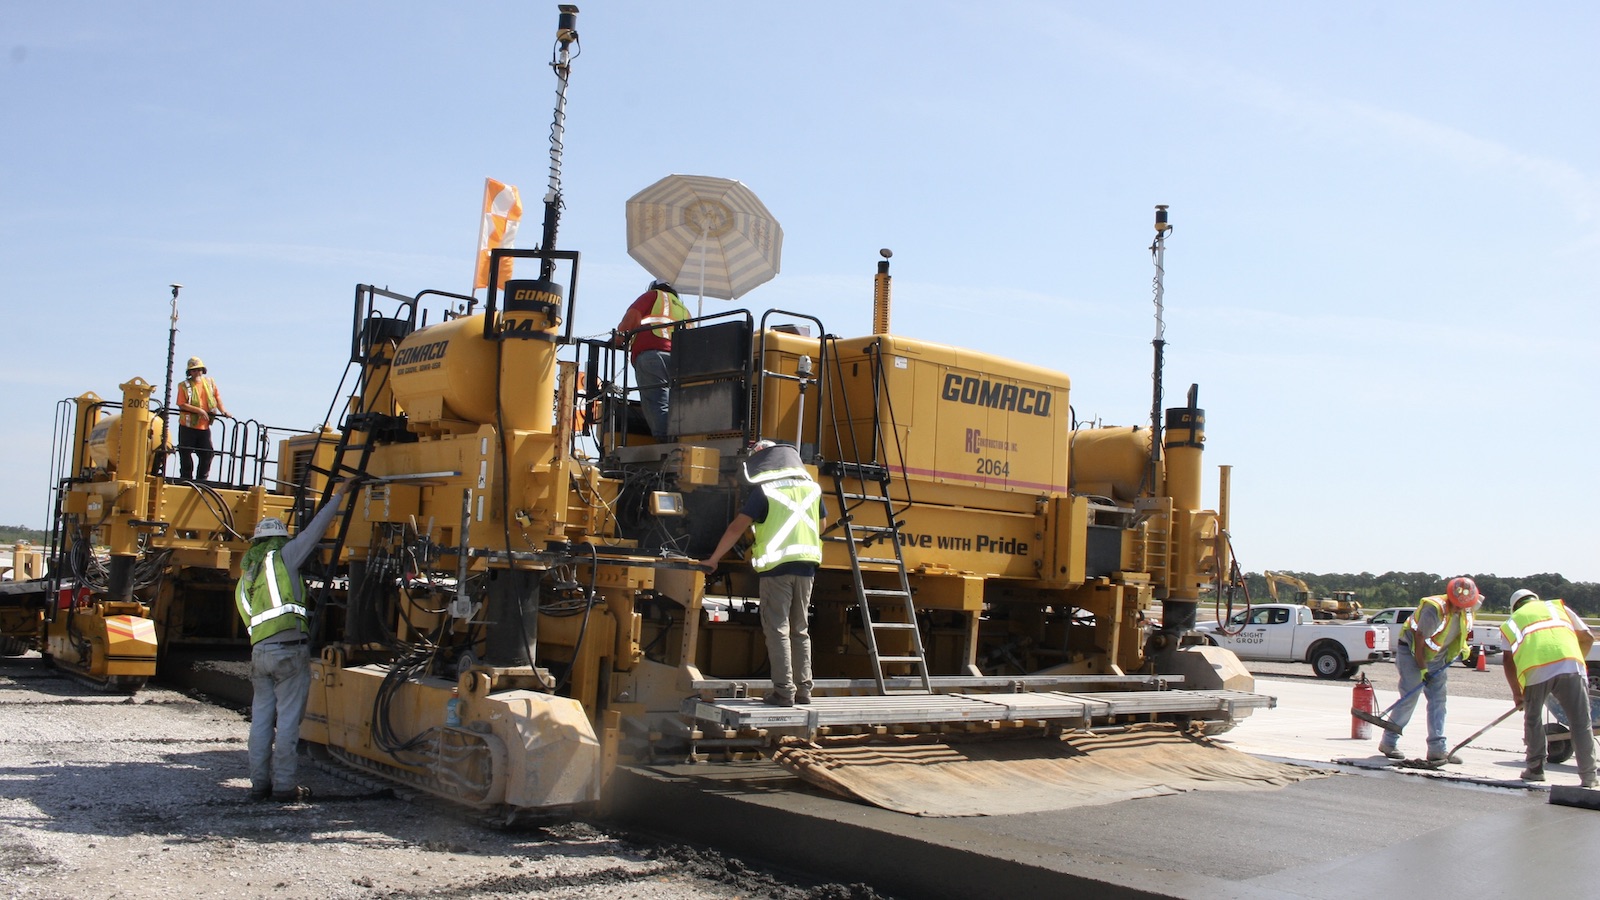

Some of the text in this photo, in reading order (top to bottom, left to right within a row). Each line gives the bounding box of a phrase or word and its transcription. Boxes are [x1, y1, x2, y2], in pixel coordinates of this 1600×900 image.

[394, 340, 449, 366] GOMACO
[942, 373, 1051, 417] GOMACO
[976, 457, 1010, 477] 2064
[938, 535, 971, 551] WITH
[976, 535, 1028, 556] Pride
